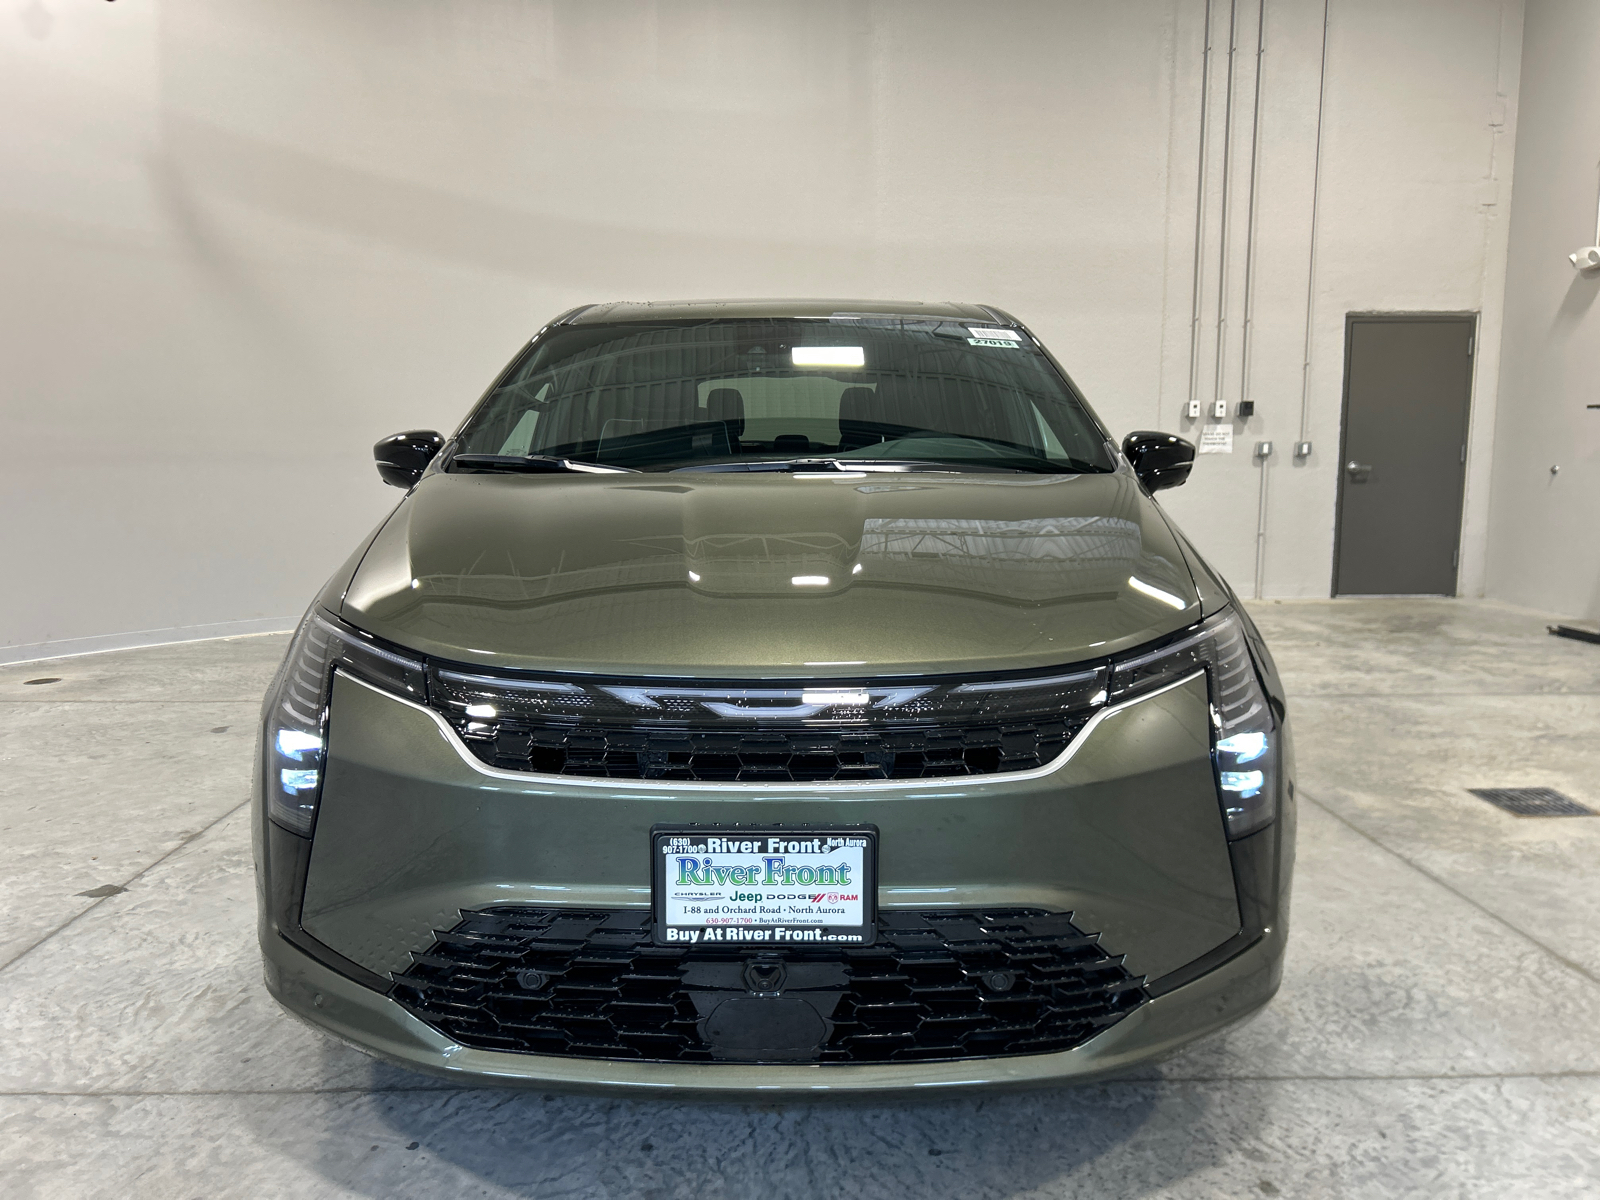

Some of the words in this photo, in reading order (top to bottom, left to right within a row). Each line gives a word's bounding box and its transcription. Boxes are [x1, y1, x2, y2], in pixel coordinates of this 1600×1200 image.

[669, 837, 691, 846] (630)
[707, 838, 761, 853] River
[767, 838, 821, 853] Front
[827, 837, 845, 847] North
[845, 838, 867, 847] Aurora
[662, 845, 698, 854] 907-1700
[675, 855, 761, 886] River
[762, 855, 852, 886] Front
[729, 890, 763, 903] Jeep
[683, 906, 702, 914] I-88
[703, 906, 720, 914] and
[721, 906, 757, 914] Orchard
[759, 906, 781, 914] Road
[788, 906, 814, 914] North
[815, 906, 846, 914] Aurora
[758, 917, 824, 925] BuyAtRiverFront.com
[666, 928, 700, 943] Buy
[703, 928, 723, 941] At
[726, 928, 774, 941] River
[774, 928, 863, 941] Front.com
